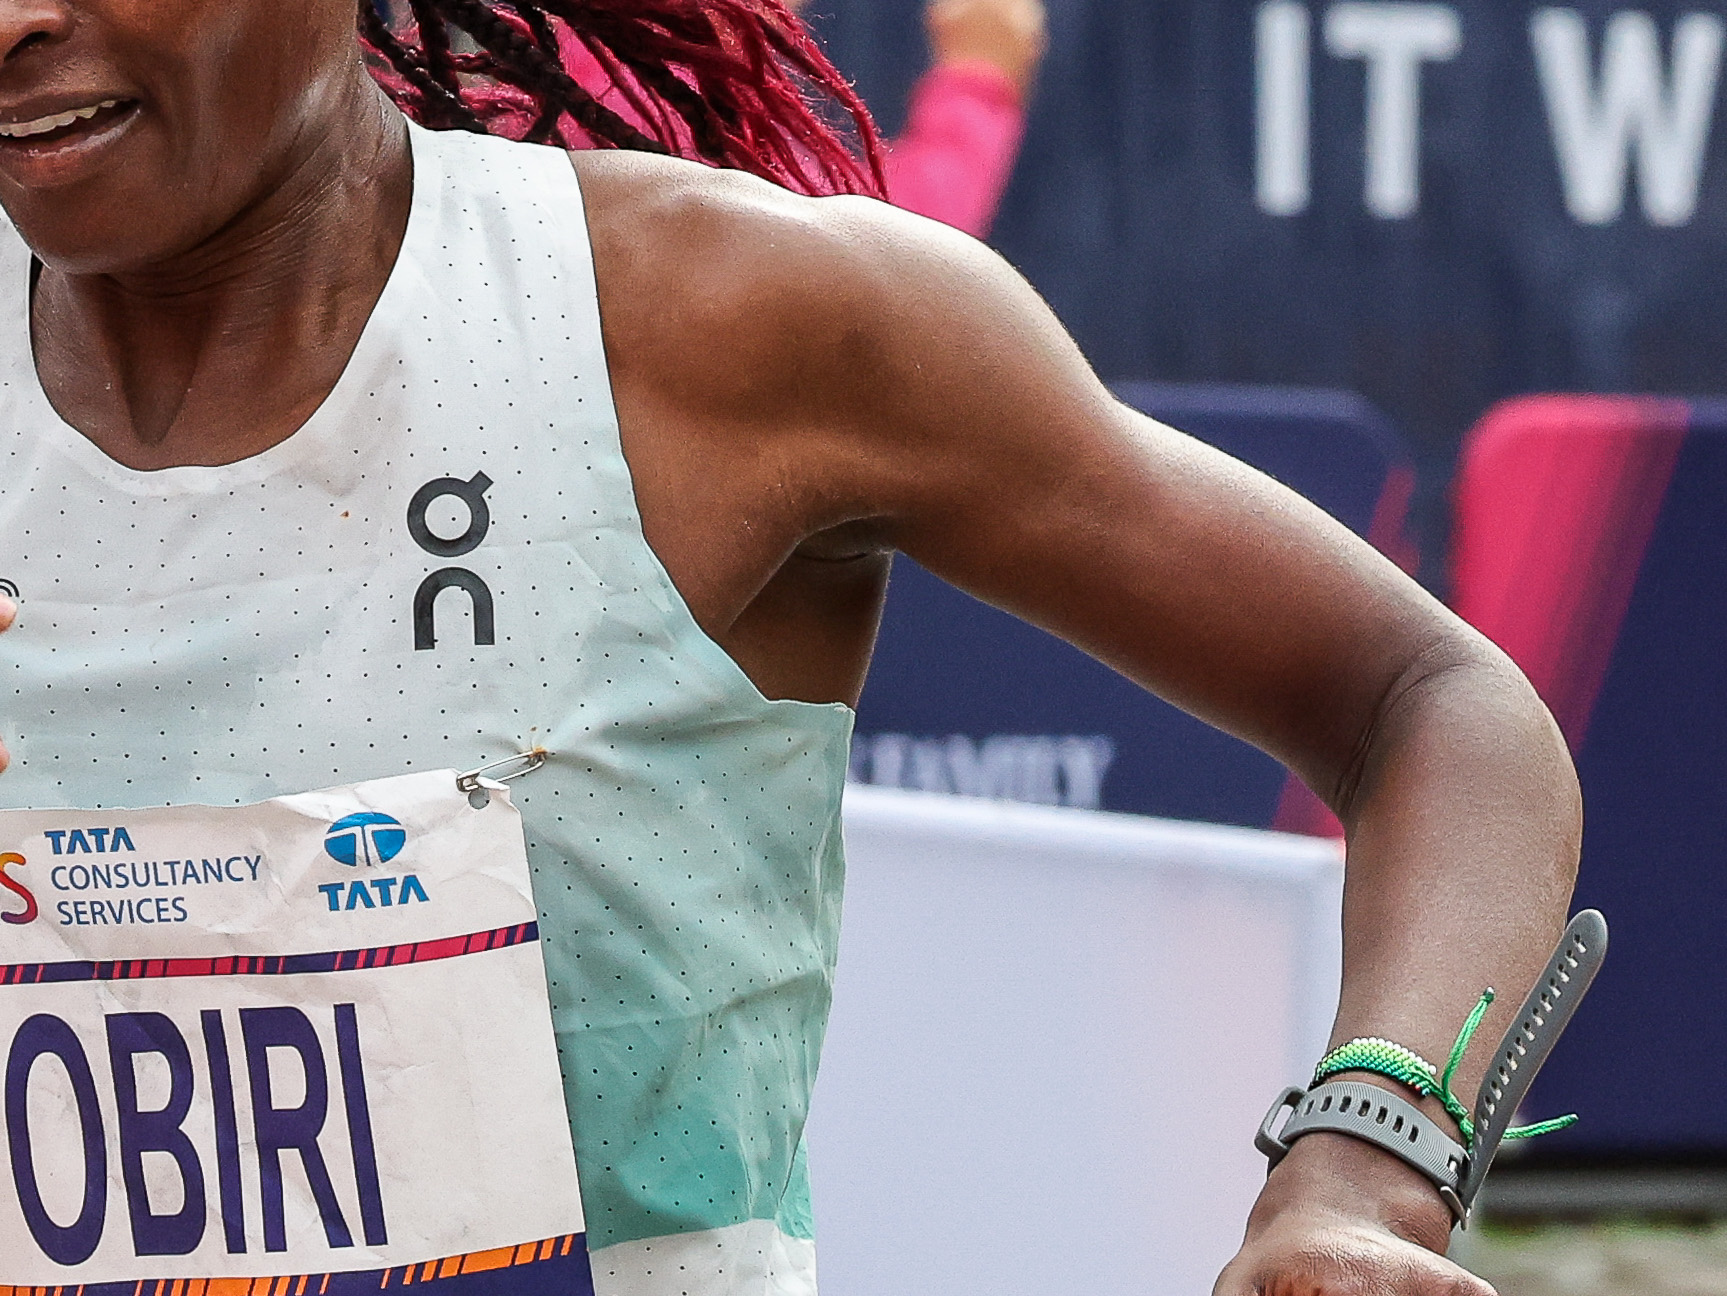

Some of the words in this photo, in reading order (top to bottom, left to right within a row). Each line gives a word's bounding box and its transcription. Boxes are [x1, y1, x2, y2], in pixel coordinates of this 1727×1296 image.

[44, 826, 136, 855] TATA
[51, 855, 261, 891] CONSULTANCY
[57, 897, 187, 925] SERVICES
[318, 874, 429, 912] TATA
[4, 1003, 389, 1267] OBIRI
